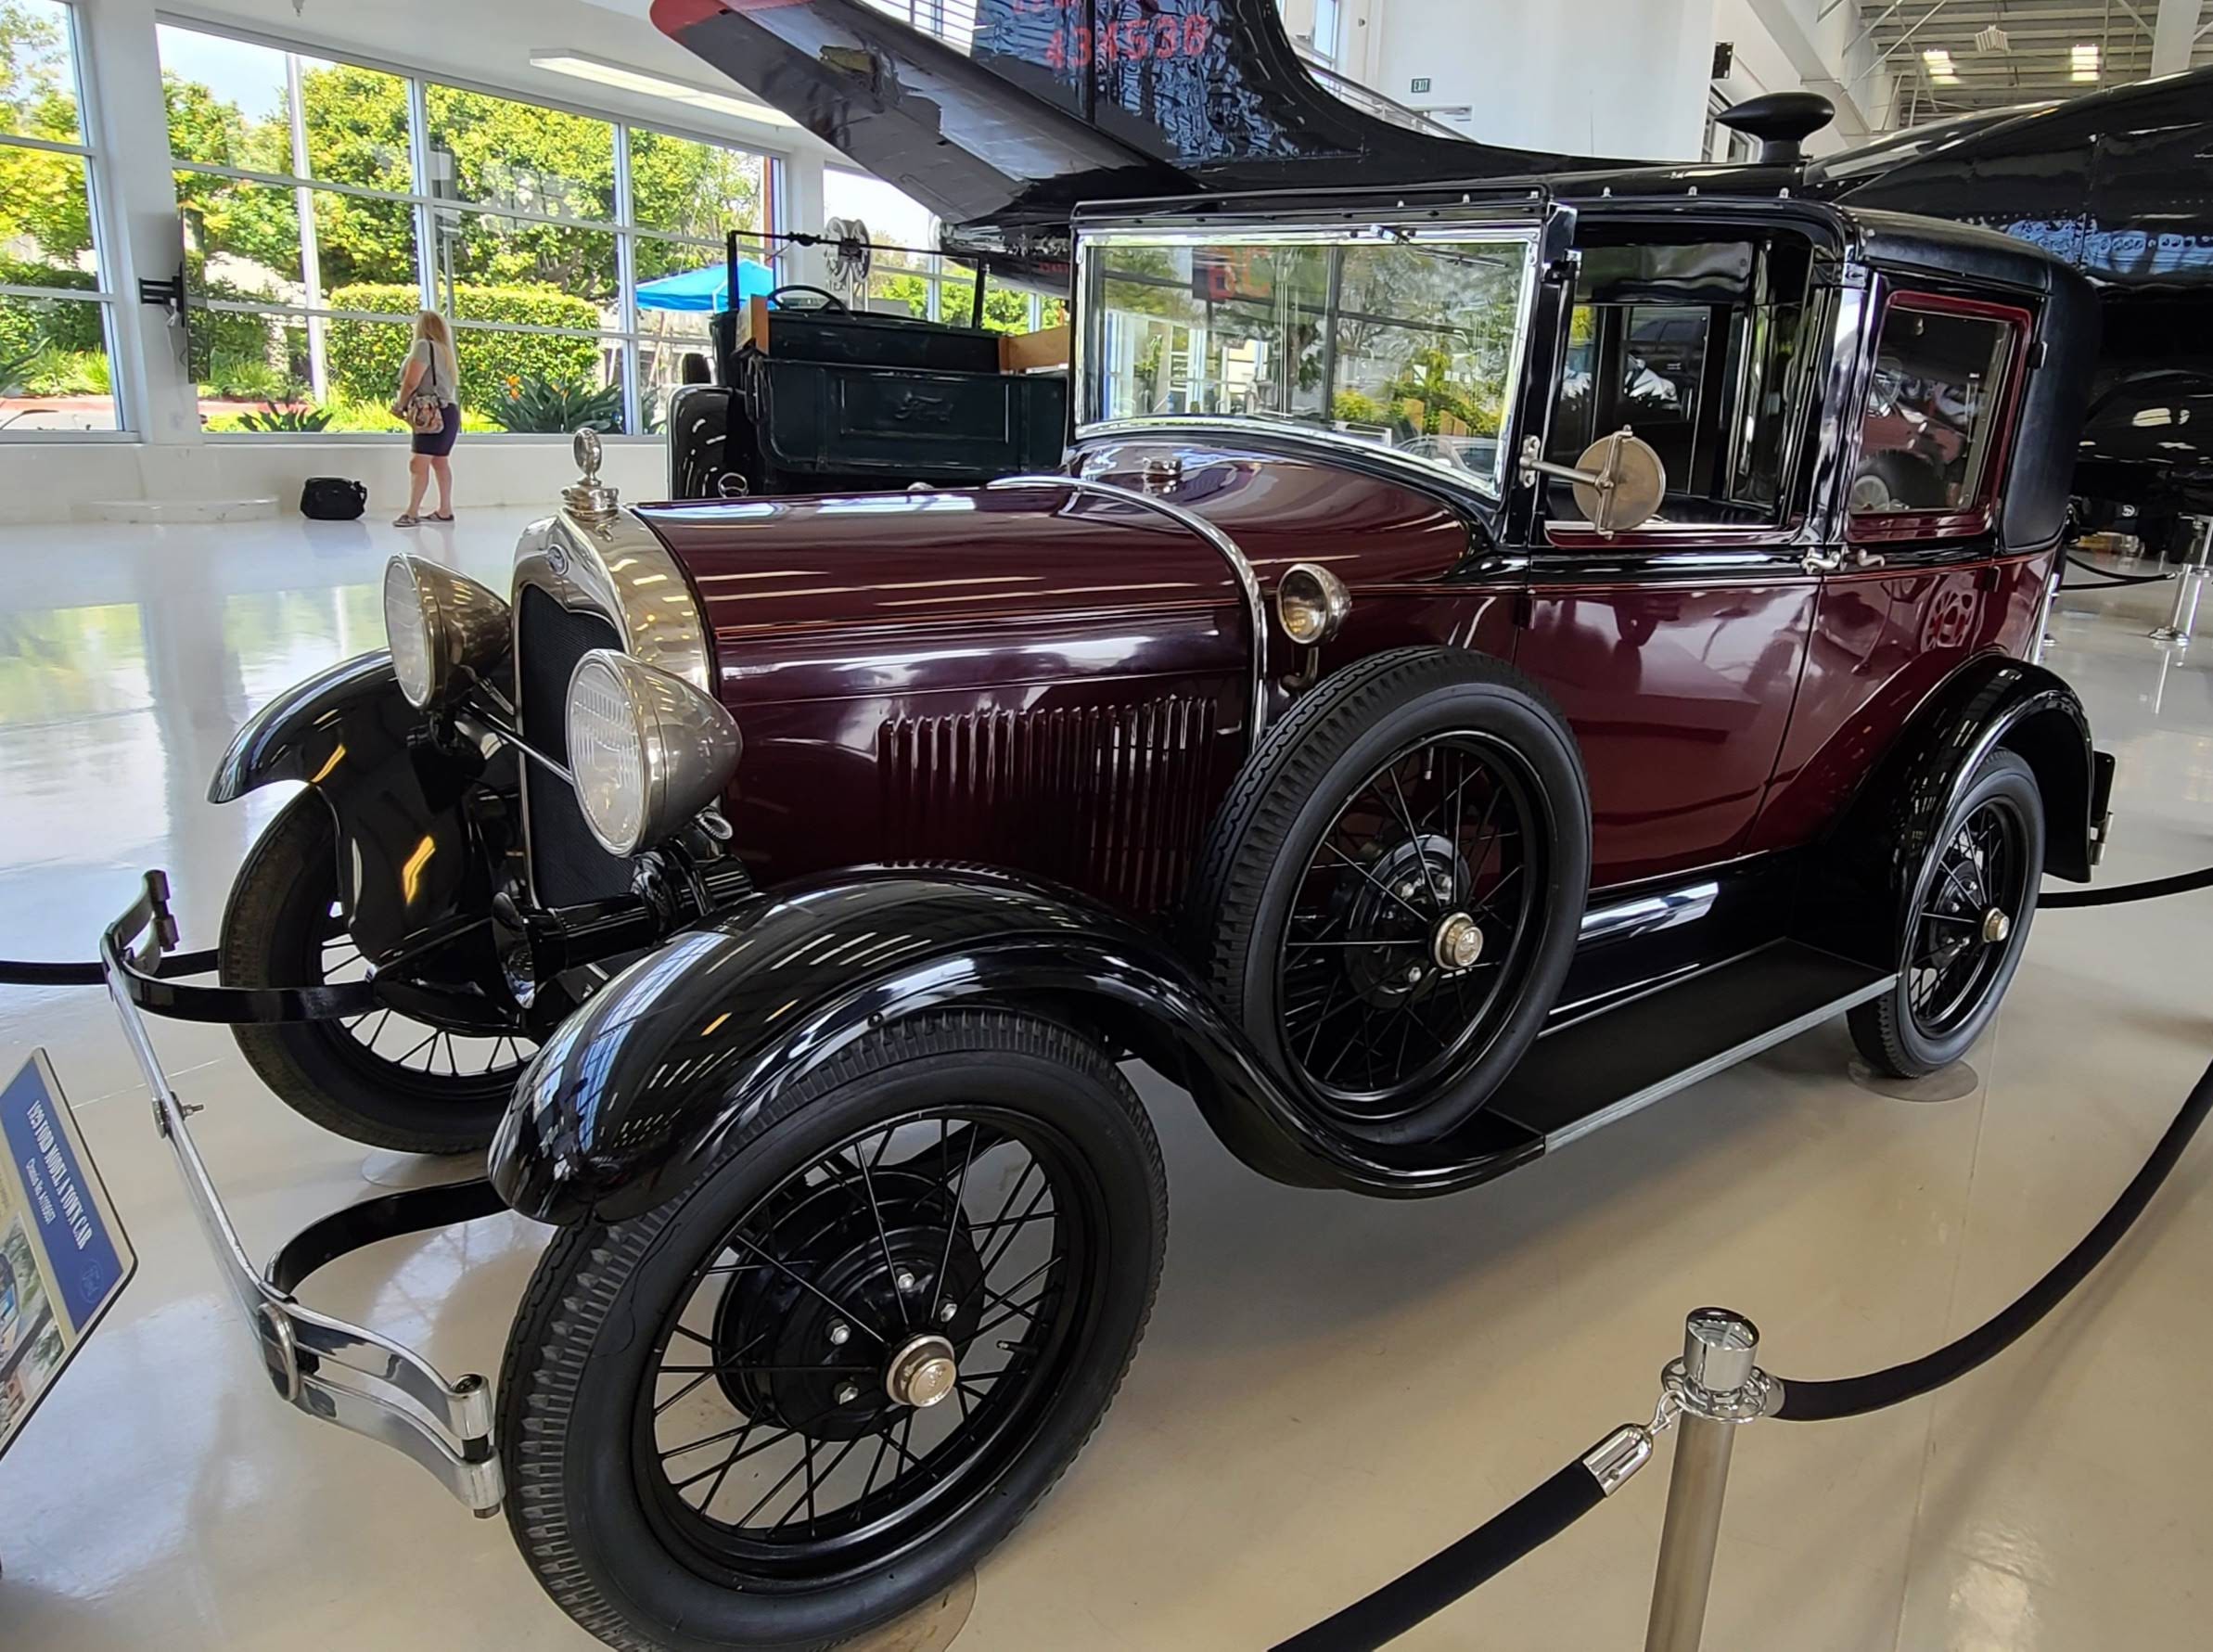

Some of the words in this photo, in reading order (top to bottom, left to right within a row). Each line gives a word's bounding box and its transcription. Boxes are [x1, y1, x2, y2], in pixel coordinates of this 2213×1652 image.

[34, 1120, 55, 1153] FORD
[44, 1144, 68, 1187] MODEL
[58, 1177, 70, 1196] A
[60, 1184, 83, 1225] TOWN
[72, 1216, 93, 1250] CAR
